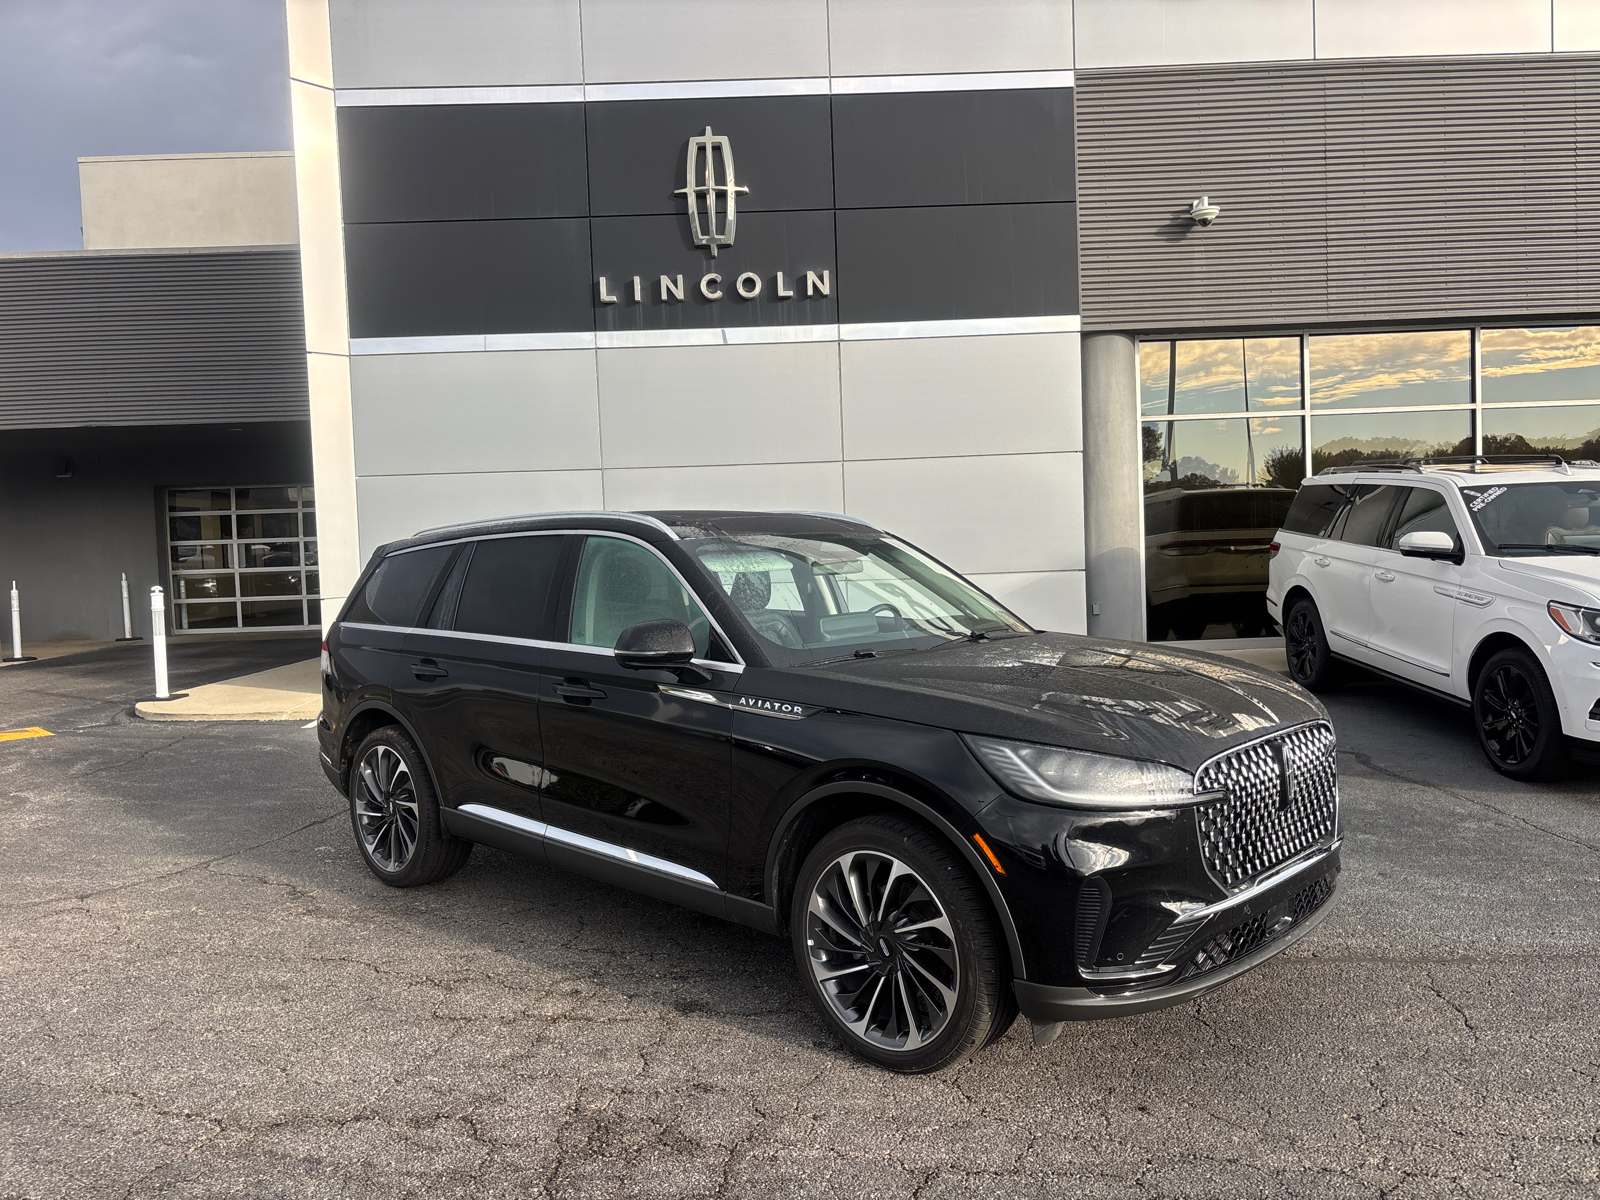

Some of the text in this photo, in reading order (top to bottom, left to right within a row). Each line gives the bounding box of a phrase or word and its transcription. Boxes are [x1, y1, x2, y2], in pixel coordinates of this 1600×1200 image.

[599, 269, 830, 304] LINCOLN
[1469, 486, 1499, 508] CERTIFIED
[1472, 486, 1508, 512] PRE-OWNED
[739, 697, 803, 714] AVIATOR
